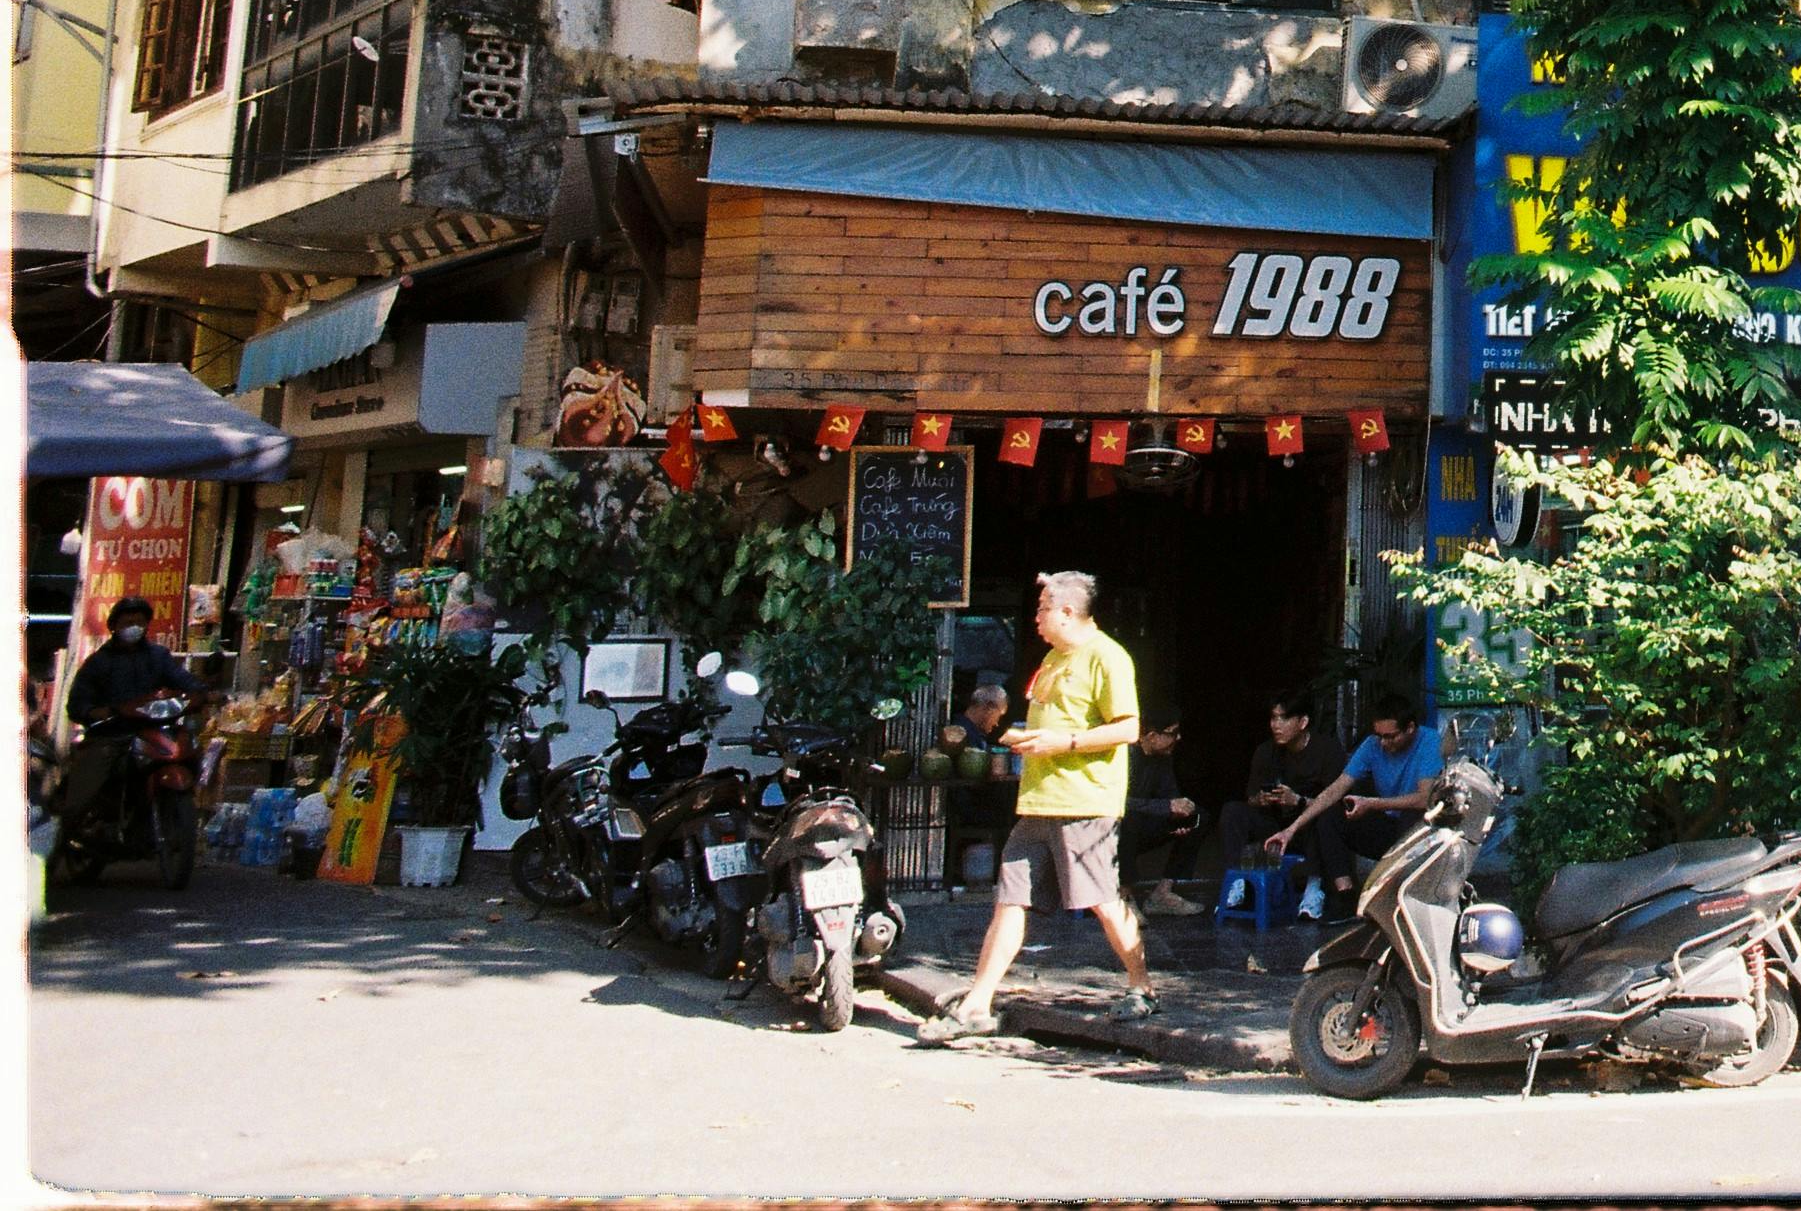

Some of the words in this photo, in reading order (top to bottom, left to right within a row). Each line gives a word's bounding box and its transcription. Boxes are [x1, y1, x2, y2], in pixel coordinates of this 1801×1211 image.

[1034, 267, 1185, 336] café
[1212, 253, 1401, 339] 1988
[1441, 449, 1476, 501] NHÀ
[128, 539, 183, 565] CHỌN
[1447, 690, 1463, 702] 35
